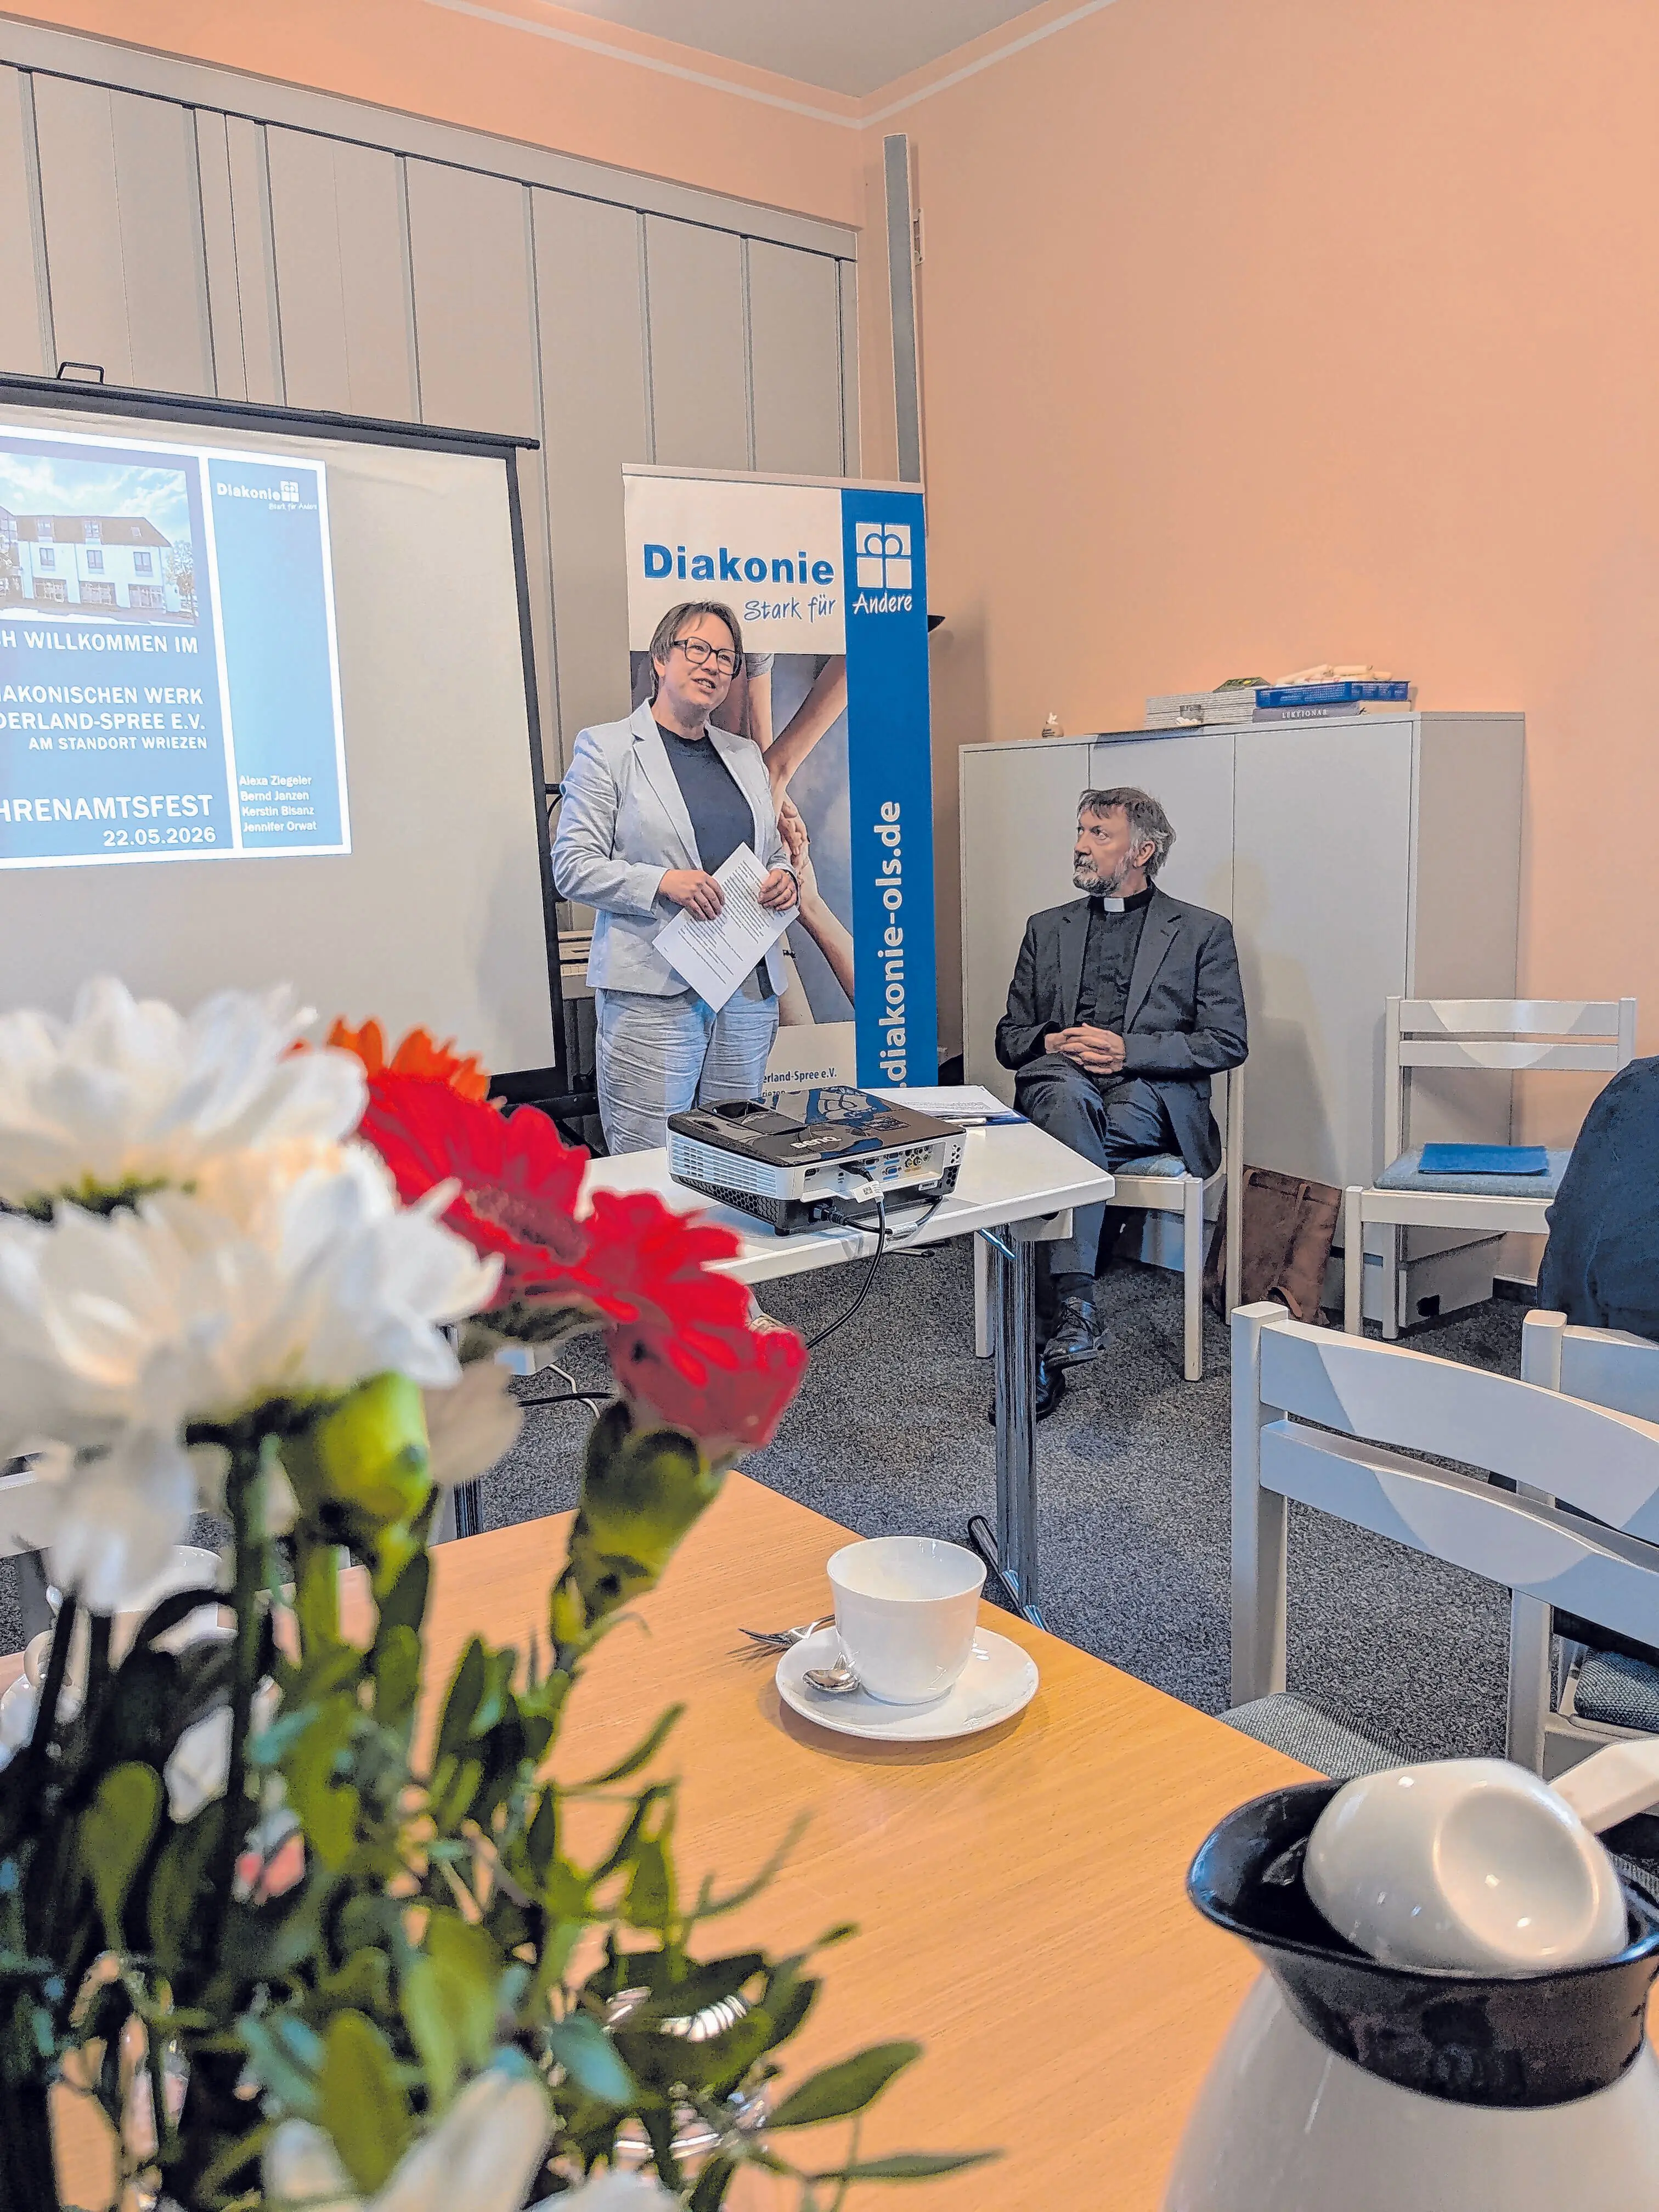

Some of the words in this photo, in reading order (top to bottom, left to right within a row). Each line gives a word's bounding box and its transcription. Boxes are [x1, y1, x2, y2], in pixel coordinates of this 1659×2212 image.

[217, 483, 281, 501] Diakonie
[643, 543, 835, 585] Diakonie
[743, 596, 803, 622] Stark
[808, 594, 837, 623] für
[852, 590, 912, 615] Andere
[0, 630, 17, 648] H
[23, 631, 168, 653] WILLKOMMEN
[174, 636, 198, 654] IM
[0, 685, 138, 704] AKONISCHEN
[144, 687, 204, 706] WERK
[171, 713, 206, 730] E.V.
[29, 737, 53, 750] AM
[58, 737, 137, 751] STANDORT
[141, 736, 207, 749] WRIEZEN
[239, 775, 268, 786] Alexa
[240, 791, 272, 801] Bernd
[274, 790, 309, 801] Janzen
[242, 806, 279, 816] Kerstin
[281, 805, 314, 816] Bisanz
[243, 821, 284, 832] Jennifer
[286, 821, 317, 831] Orwat
[103, 826, 217, 847] 22.05.2026
[821, 1068, 837, 1078] e.V.
